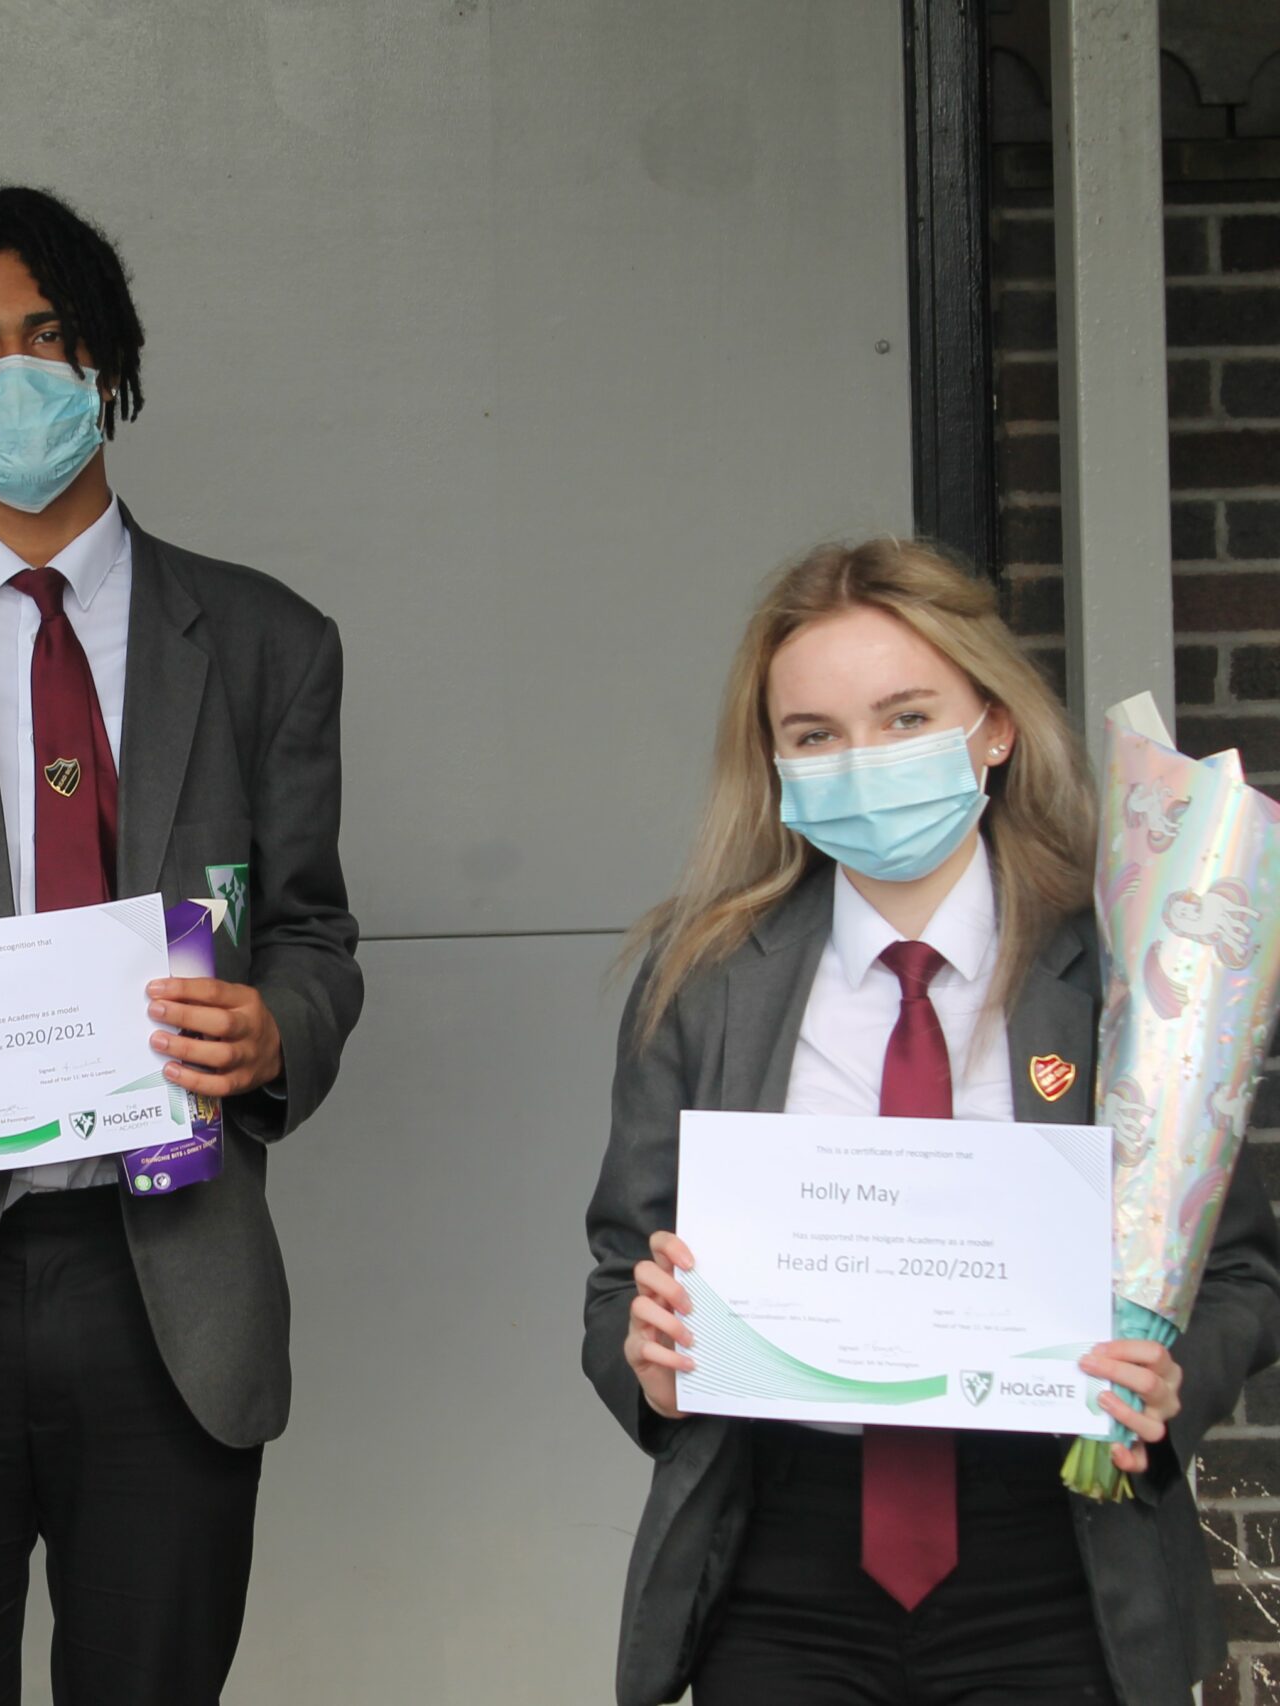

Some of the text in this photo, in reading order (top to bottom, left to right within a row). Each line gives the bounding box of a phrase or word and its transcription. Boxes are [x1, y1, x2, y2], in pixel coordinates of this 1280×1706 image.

[37, 938, 53, 947] that
[8, 1013, 40, 1024] Academy
[57, 1005, 80, 1015] model
[5, 1021, 96, 1049] 2020/2021
[102, 1105, 163, 1127] HOLGATE
[800, 1182, 900, 1206] Holly May
[777, 1253, 828, 1272] Head
[835, 1255, 869, 1274] Girl
[898, 1258, 1009, 1280] 2020/2021
[1000, 1381, 1076, 1400] HOLGATE
